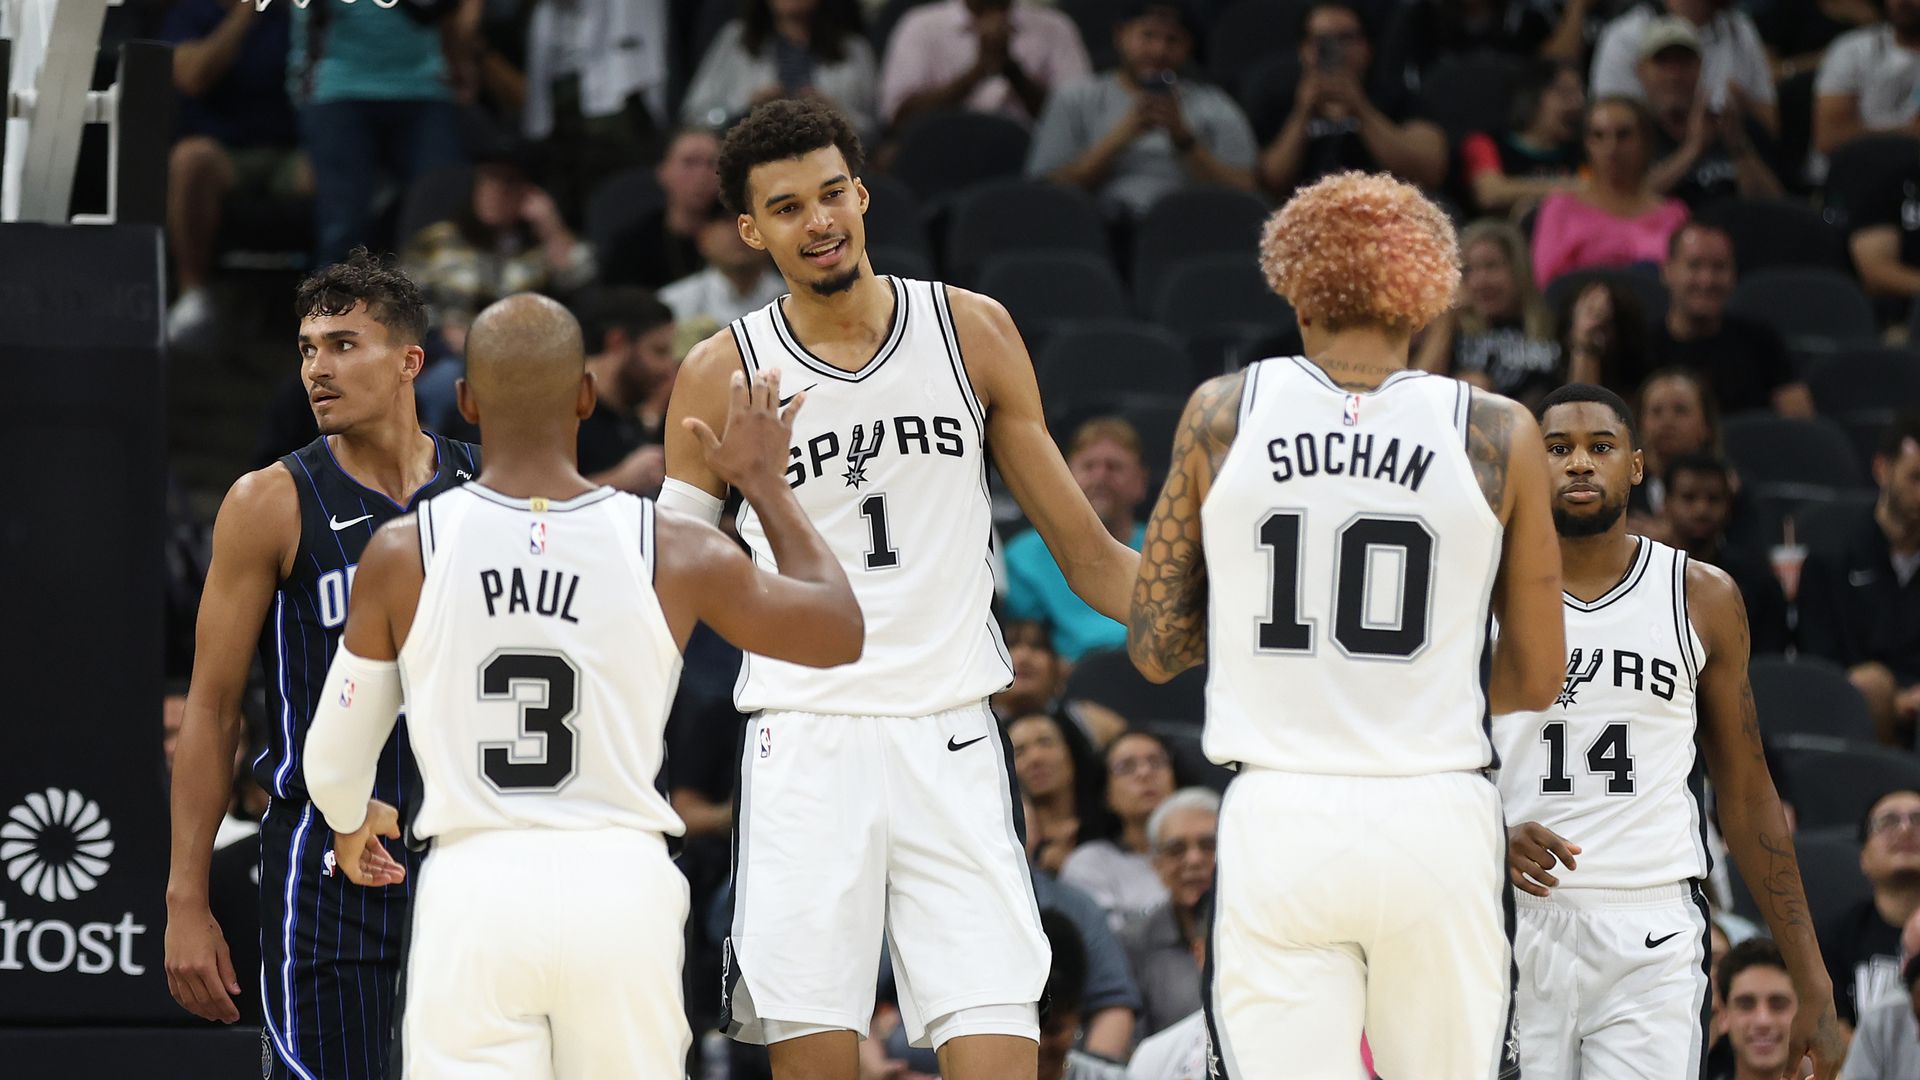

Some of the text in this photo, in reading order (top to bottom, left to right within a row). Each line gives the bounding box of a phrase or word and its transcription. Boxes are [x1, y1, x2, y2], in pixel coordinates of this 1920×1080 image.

[1267, 432, 1436, 492] SOCHAN
[859, 492, 900, 572] 1
[480, 567, 580, 624] PAUL
[1253, 507, 1441, 665] 10
[477, 647, 581, 796] 3
[1540, 720, 1637, 796] 14
